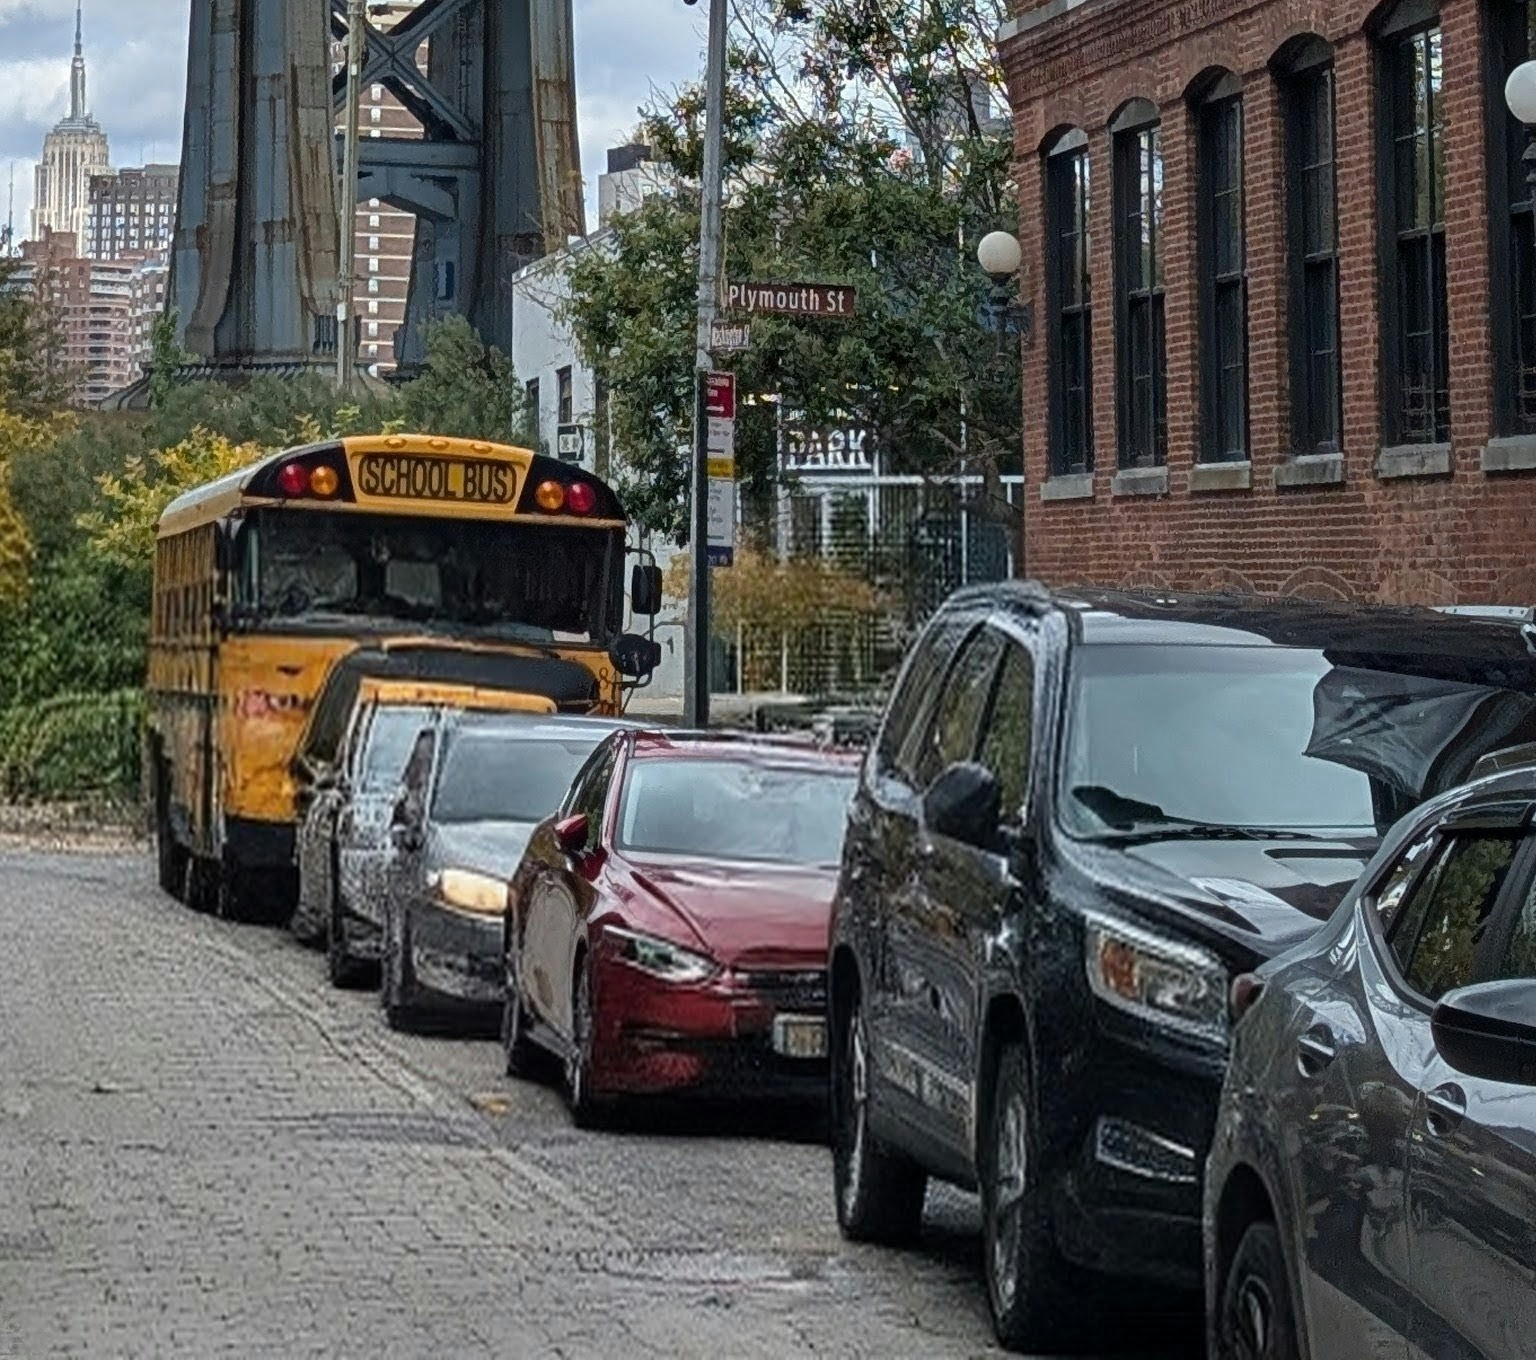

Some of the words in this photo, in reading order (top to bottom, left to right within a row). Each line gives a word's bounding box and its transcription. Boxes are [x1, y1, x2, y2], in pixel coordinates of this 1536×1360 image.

[729, 284, 820, 312] Plymouth
[827, 290, 845, 313] St
[365, 456, 457, 498] SCHOOL
[464, 462, 508, 502] BUS
